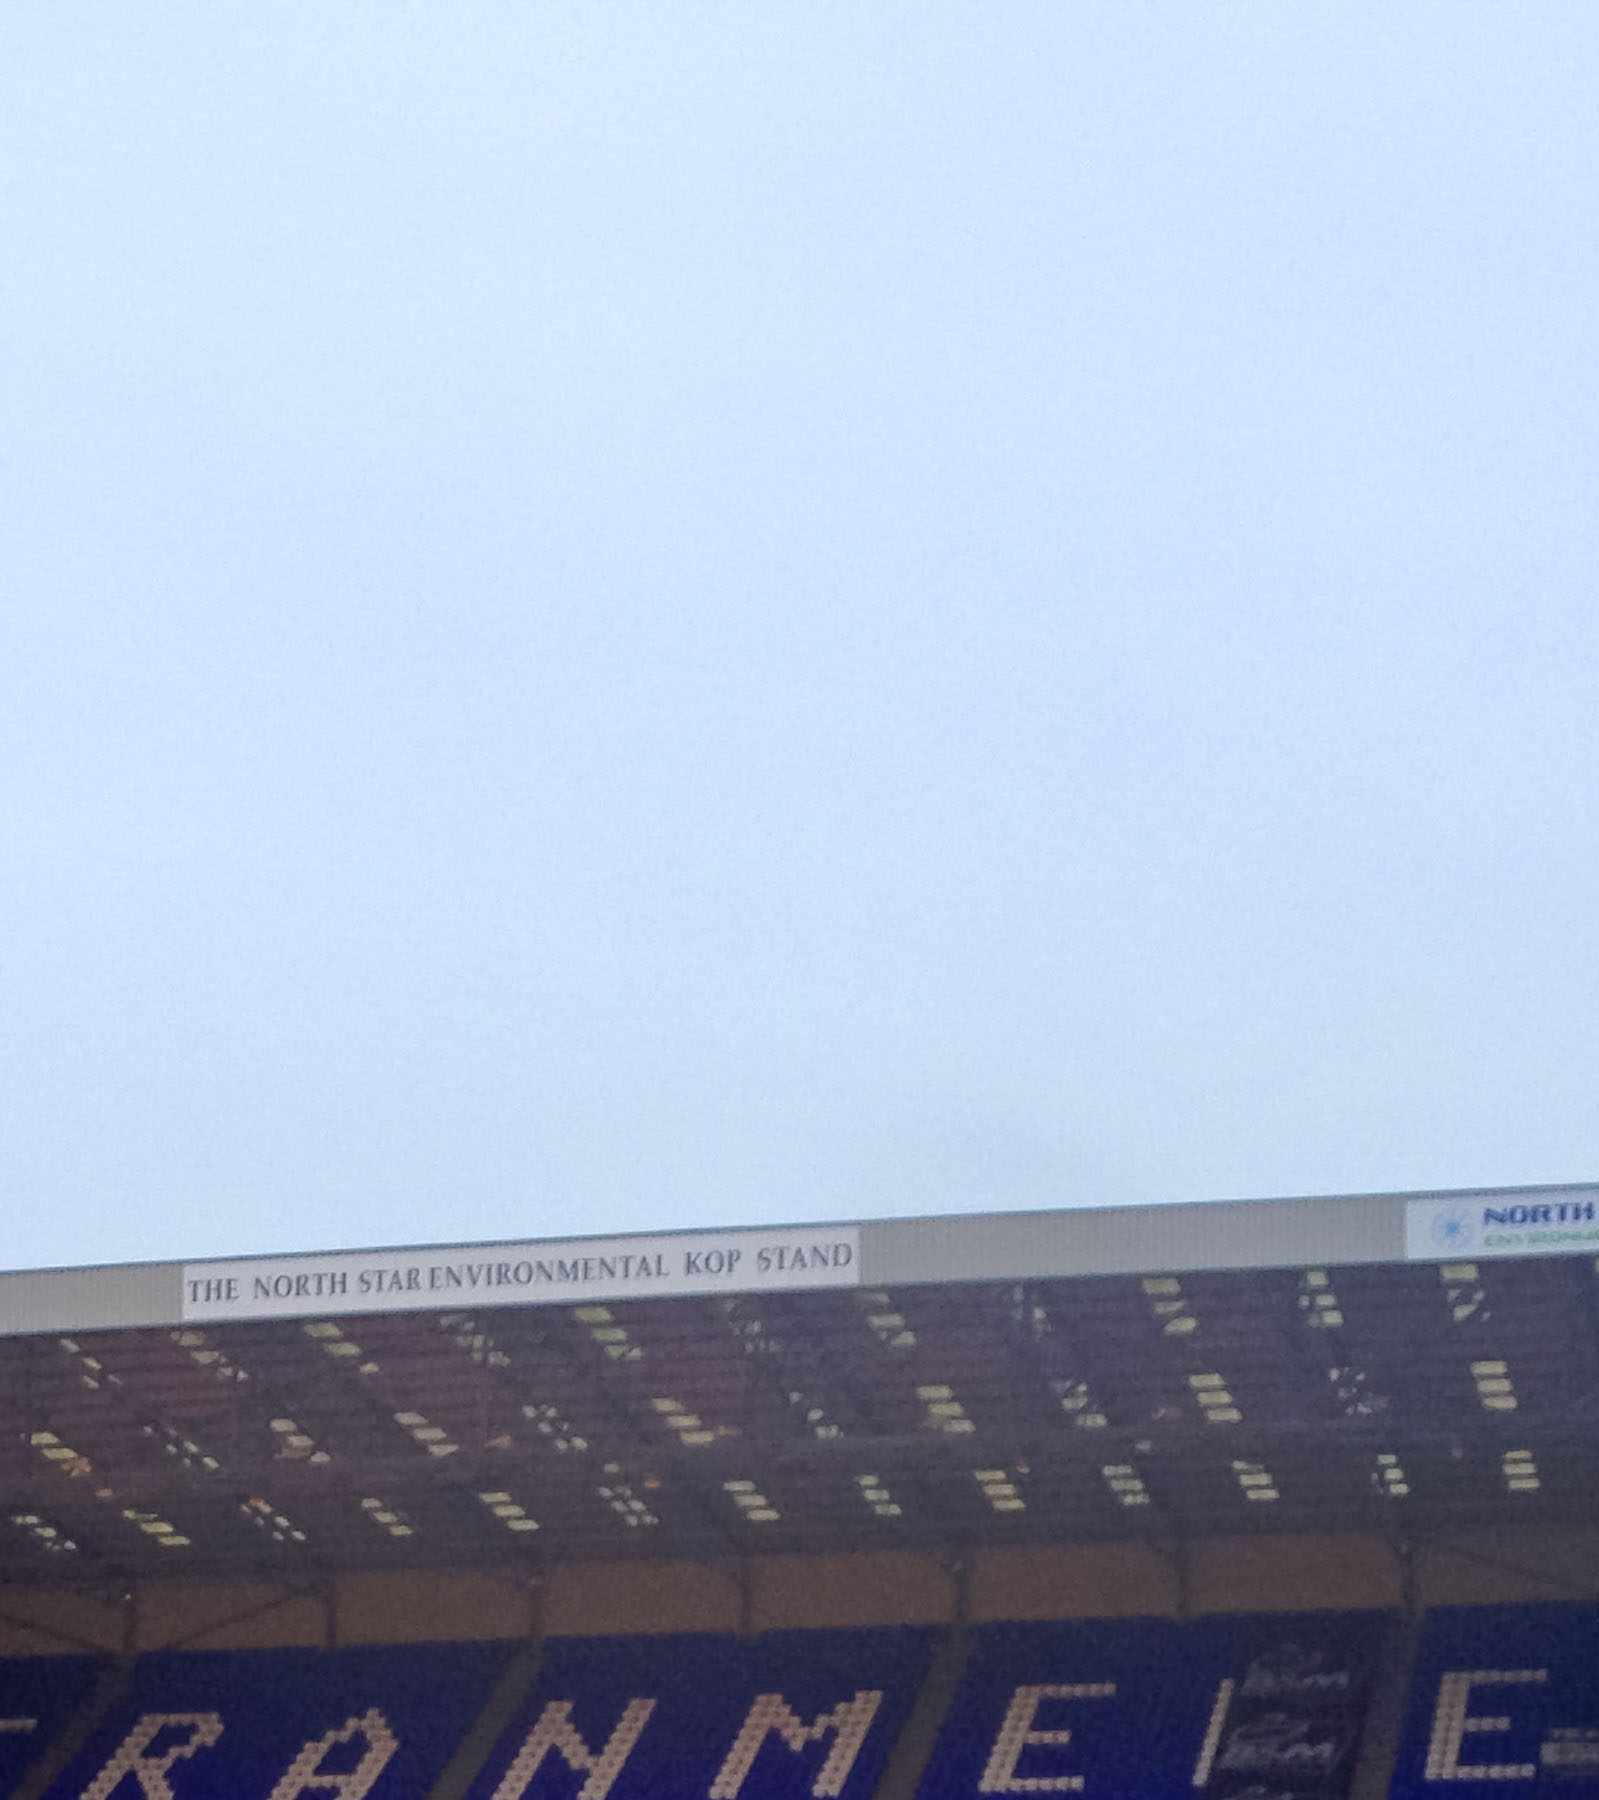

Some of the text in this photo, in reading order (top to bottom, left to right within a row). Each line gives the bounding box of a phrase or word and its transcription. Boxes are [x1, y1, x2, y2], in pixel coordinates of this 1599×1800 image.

[1483, 1201, 1595, 1225] NORTH
[187, 1243, 853, 1303] THE NORTH STAR ENVIRONMENTAL KOP STAND
